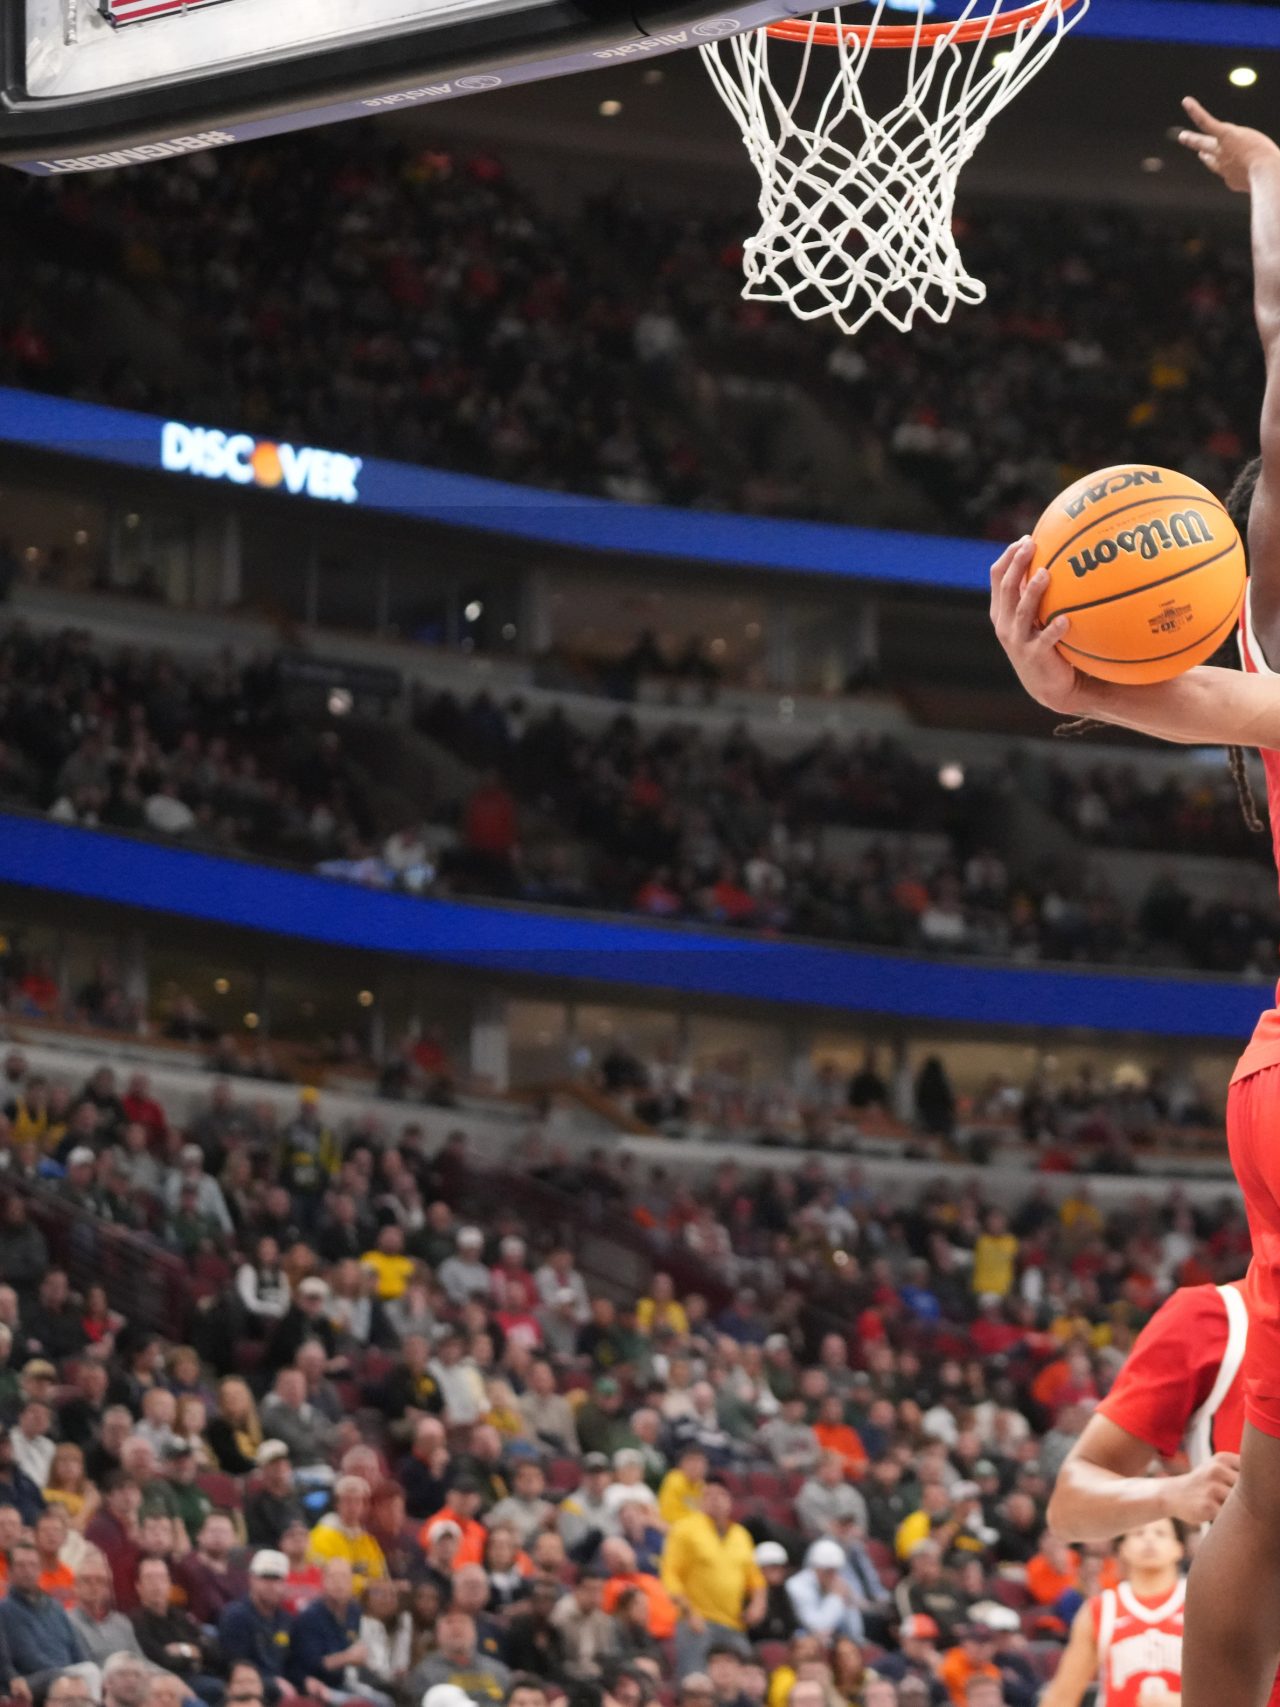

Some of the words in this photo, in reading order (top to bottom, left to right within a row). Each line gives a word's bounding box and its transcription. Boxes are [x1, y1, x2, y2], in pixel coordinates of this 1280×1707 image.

[593, 31, 688, 59] Allstate
[361, 83, 451, 108] Allstate
[161, 421, 359, 504] DISCOVER
[1064, 470, 1163, 520] NCAA
[1066, 509, 1215, 578] Wilson
